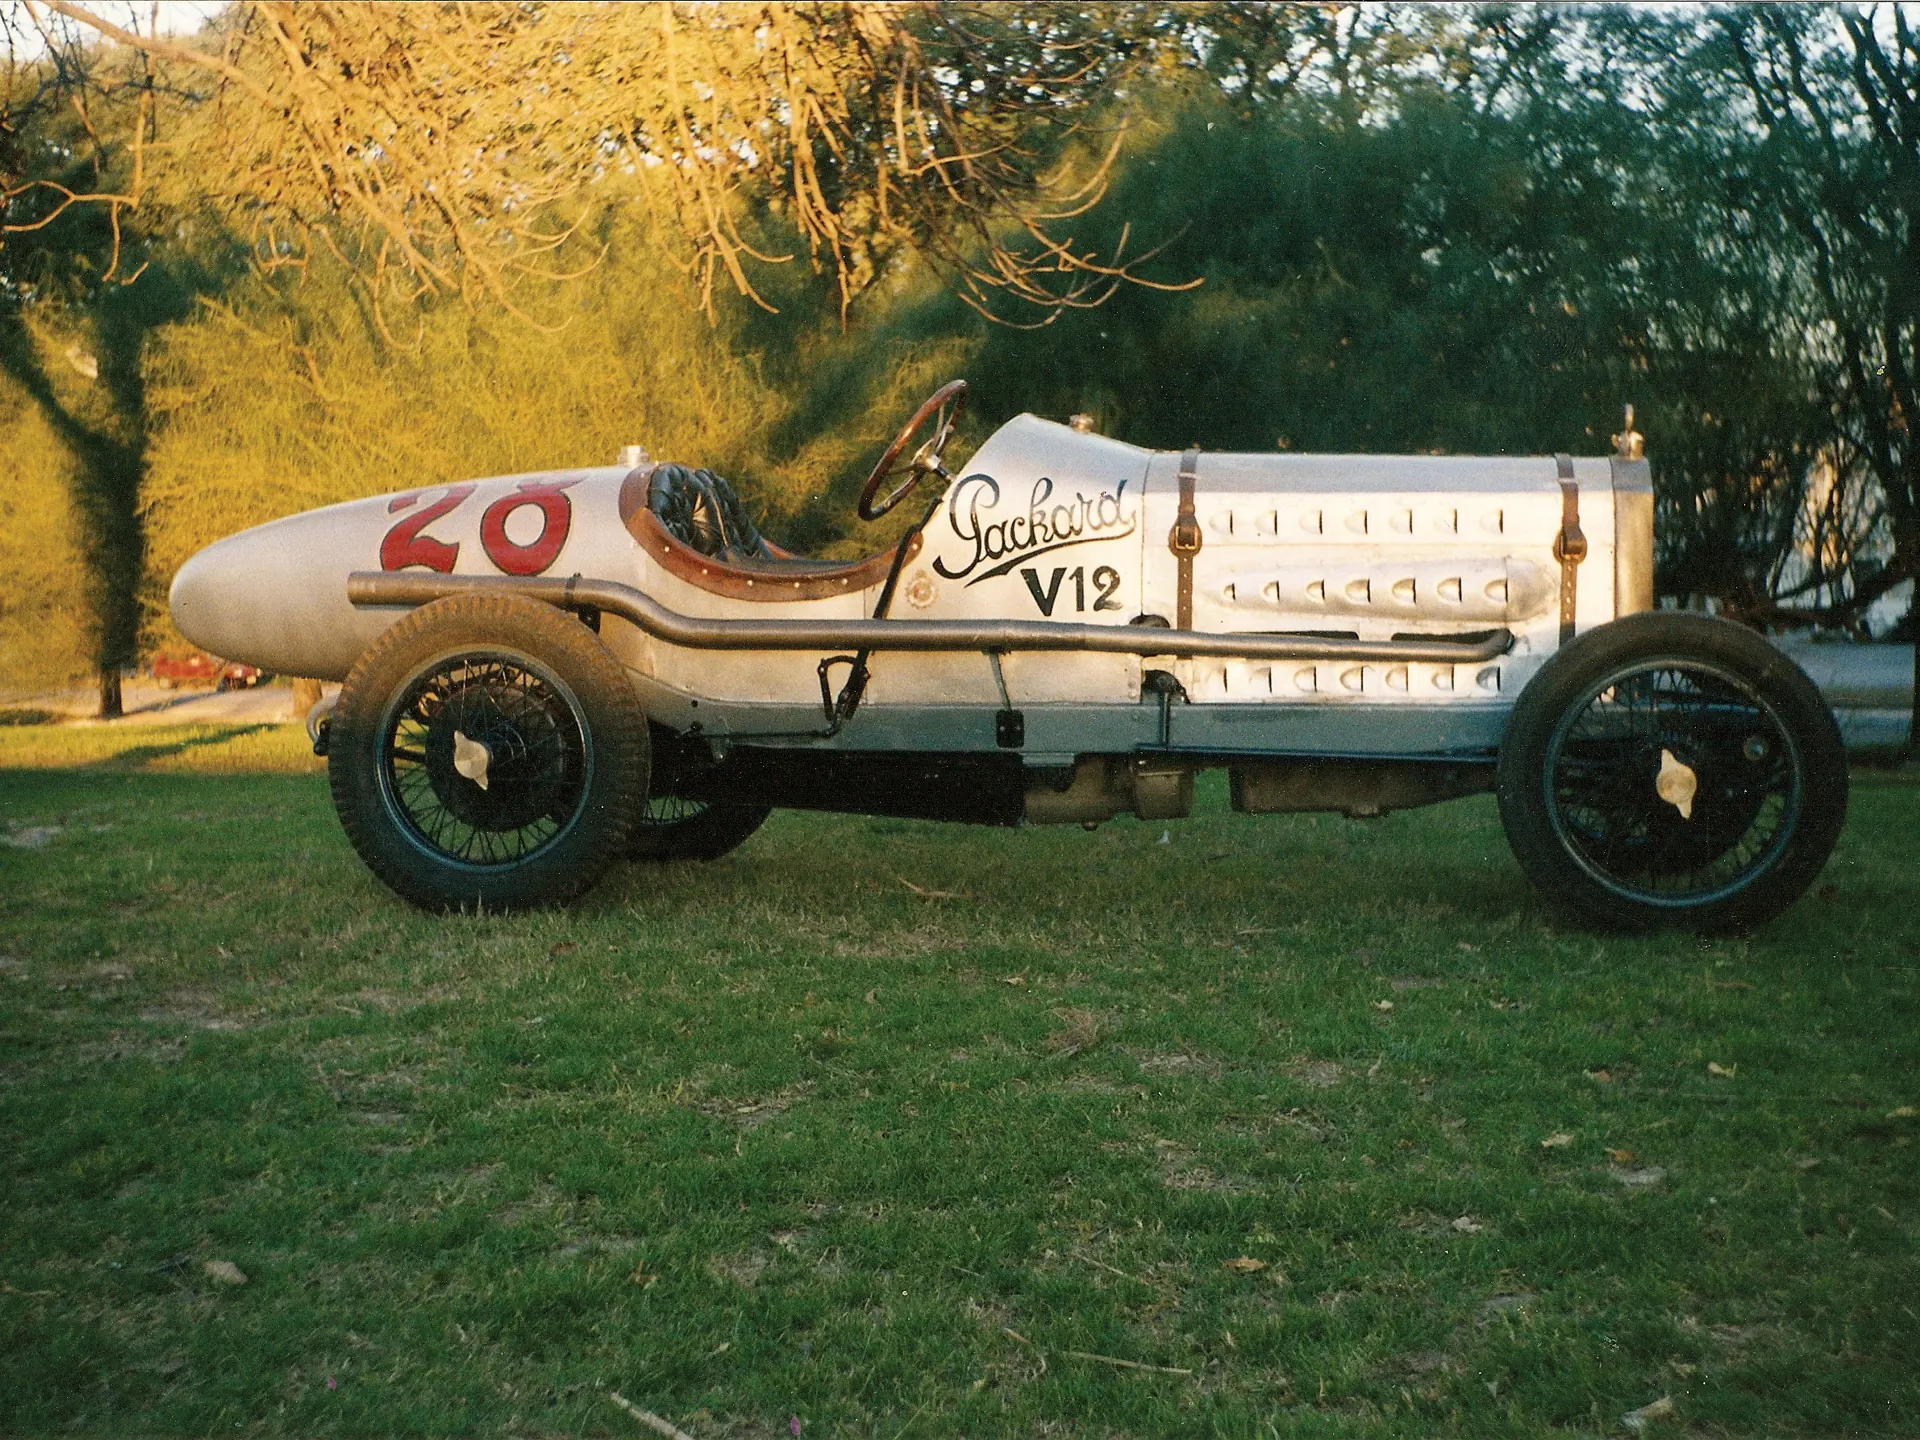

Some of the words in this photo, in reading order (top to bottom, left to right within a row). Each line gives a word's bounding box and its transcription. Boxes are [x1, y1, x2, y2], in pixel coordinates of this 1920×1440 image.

[379, 476, 589, 577] 20
[932, 473, 1137, 580] Packard
[1020, 565, 1124, 617] V12
